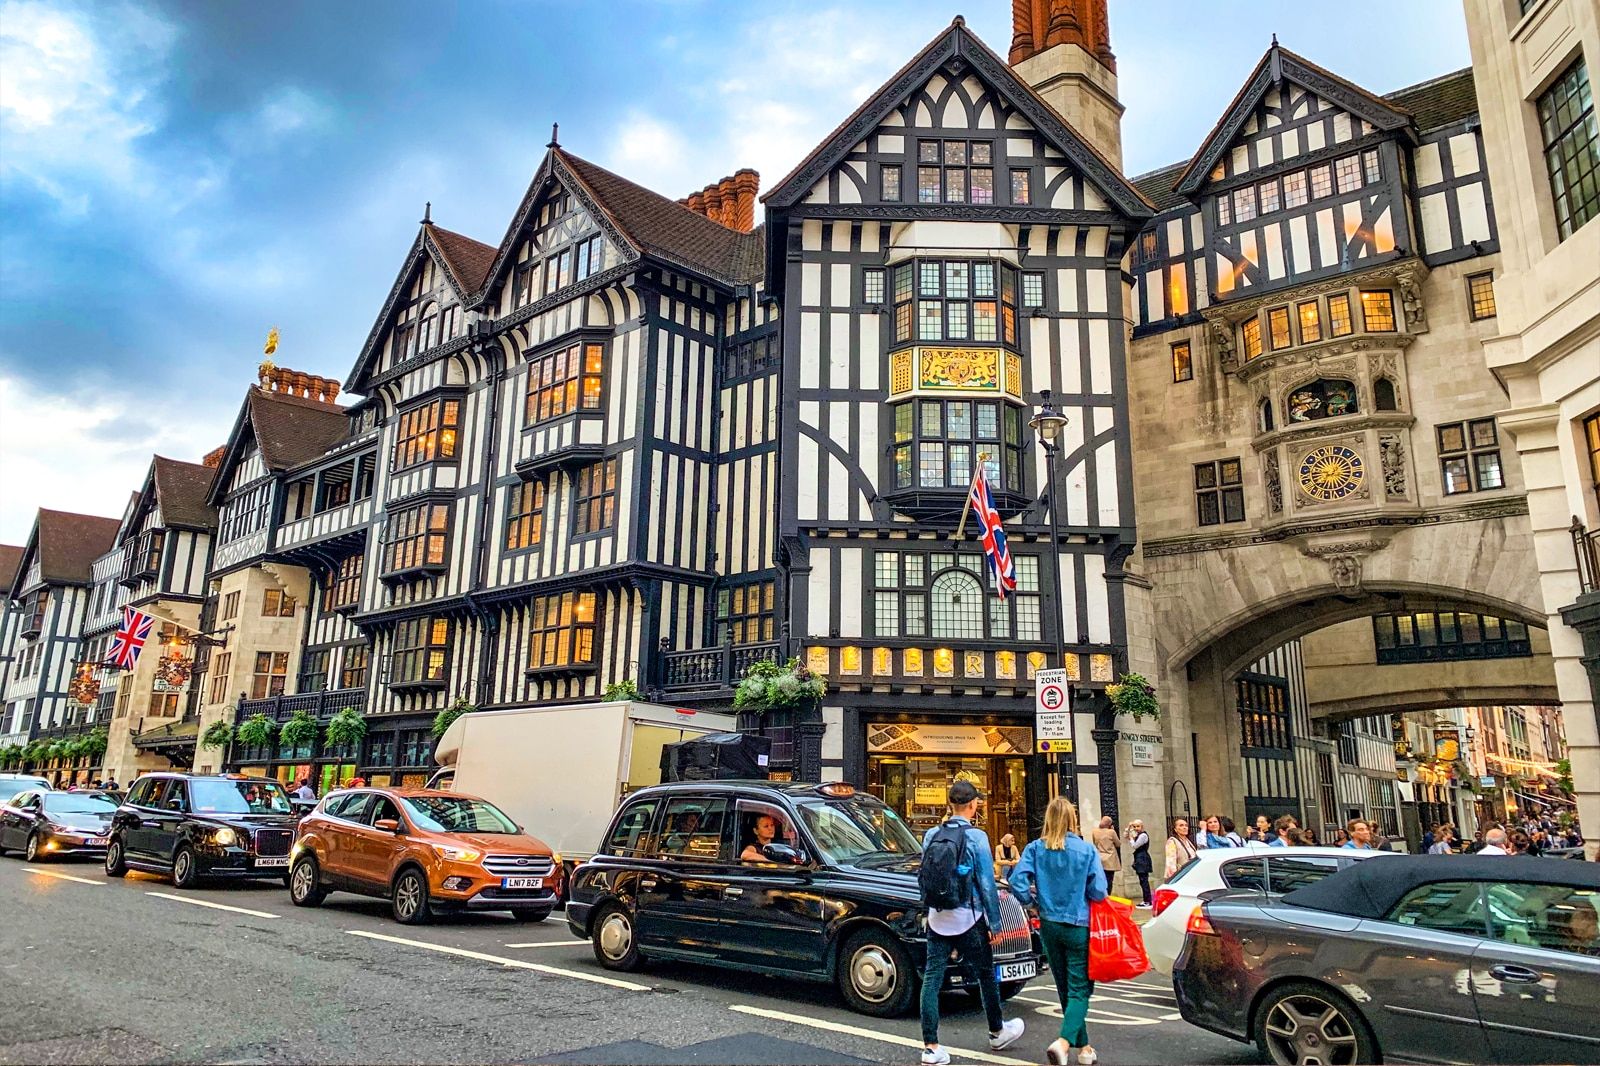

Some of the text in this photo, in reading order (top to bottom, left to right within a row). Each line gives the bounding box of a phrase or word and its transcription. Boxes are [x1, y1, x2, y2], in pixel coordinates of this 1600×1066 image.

[1121, 733, 1139, 741] KINGLY
[1140, 735, 1156, 743] STREET
[1001, 963, 1035, 978] LS64 KTX
